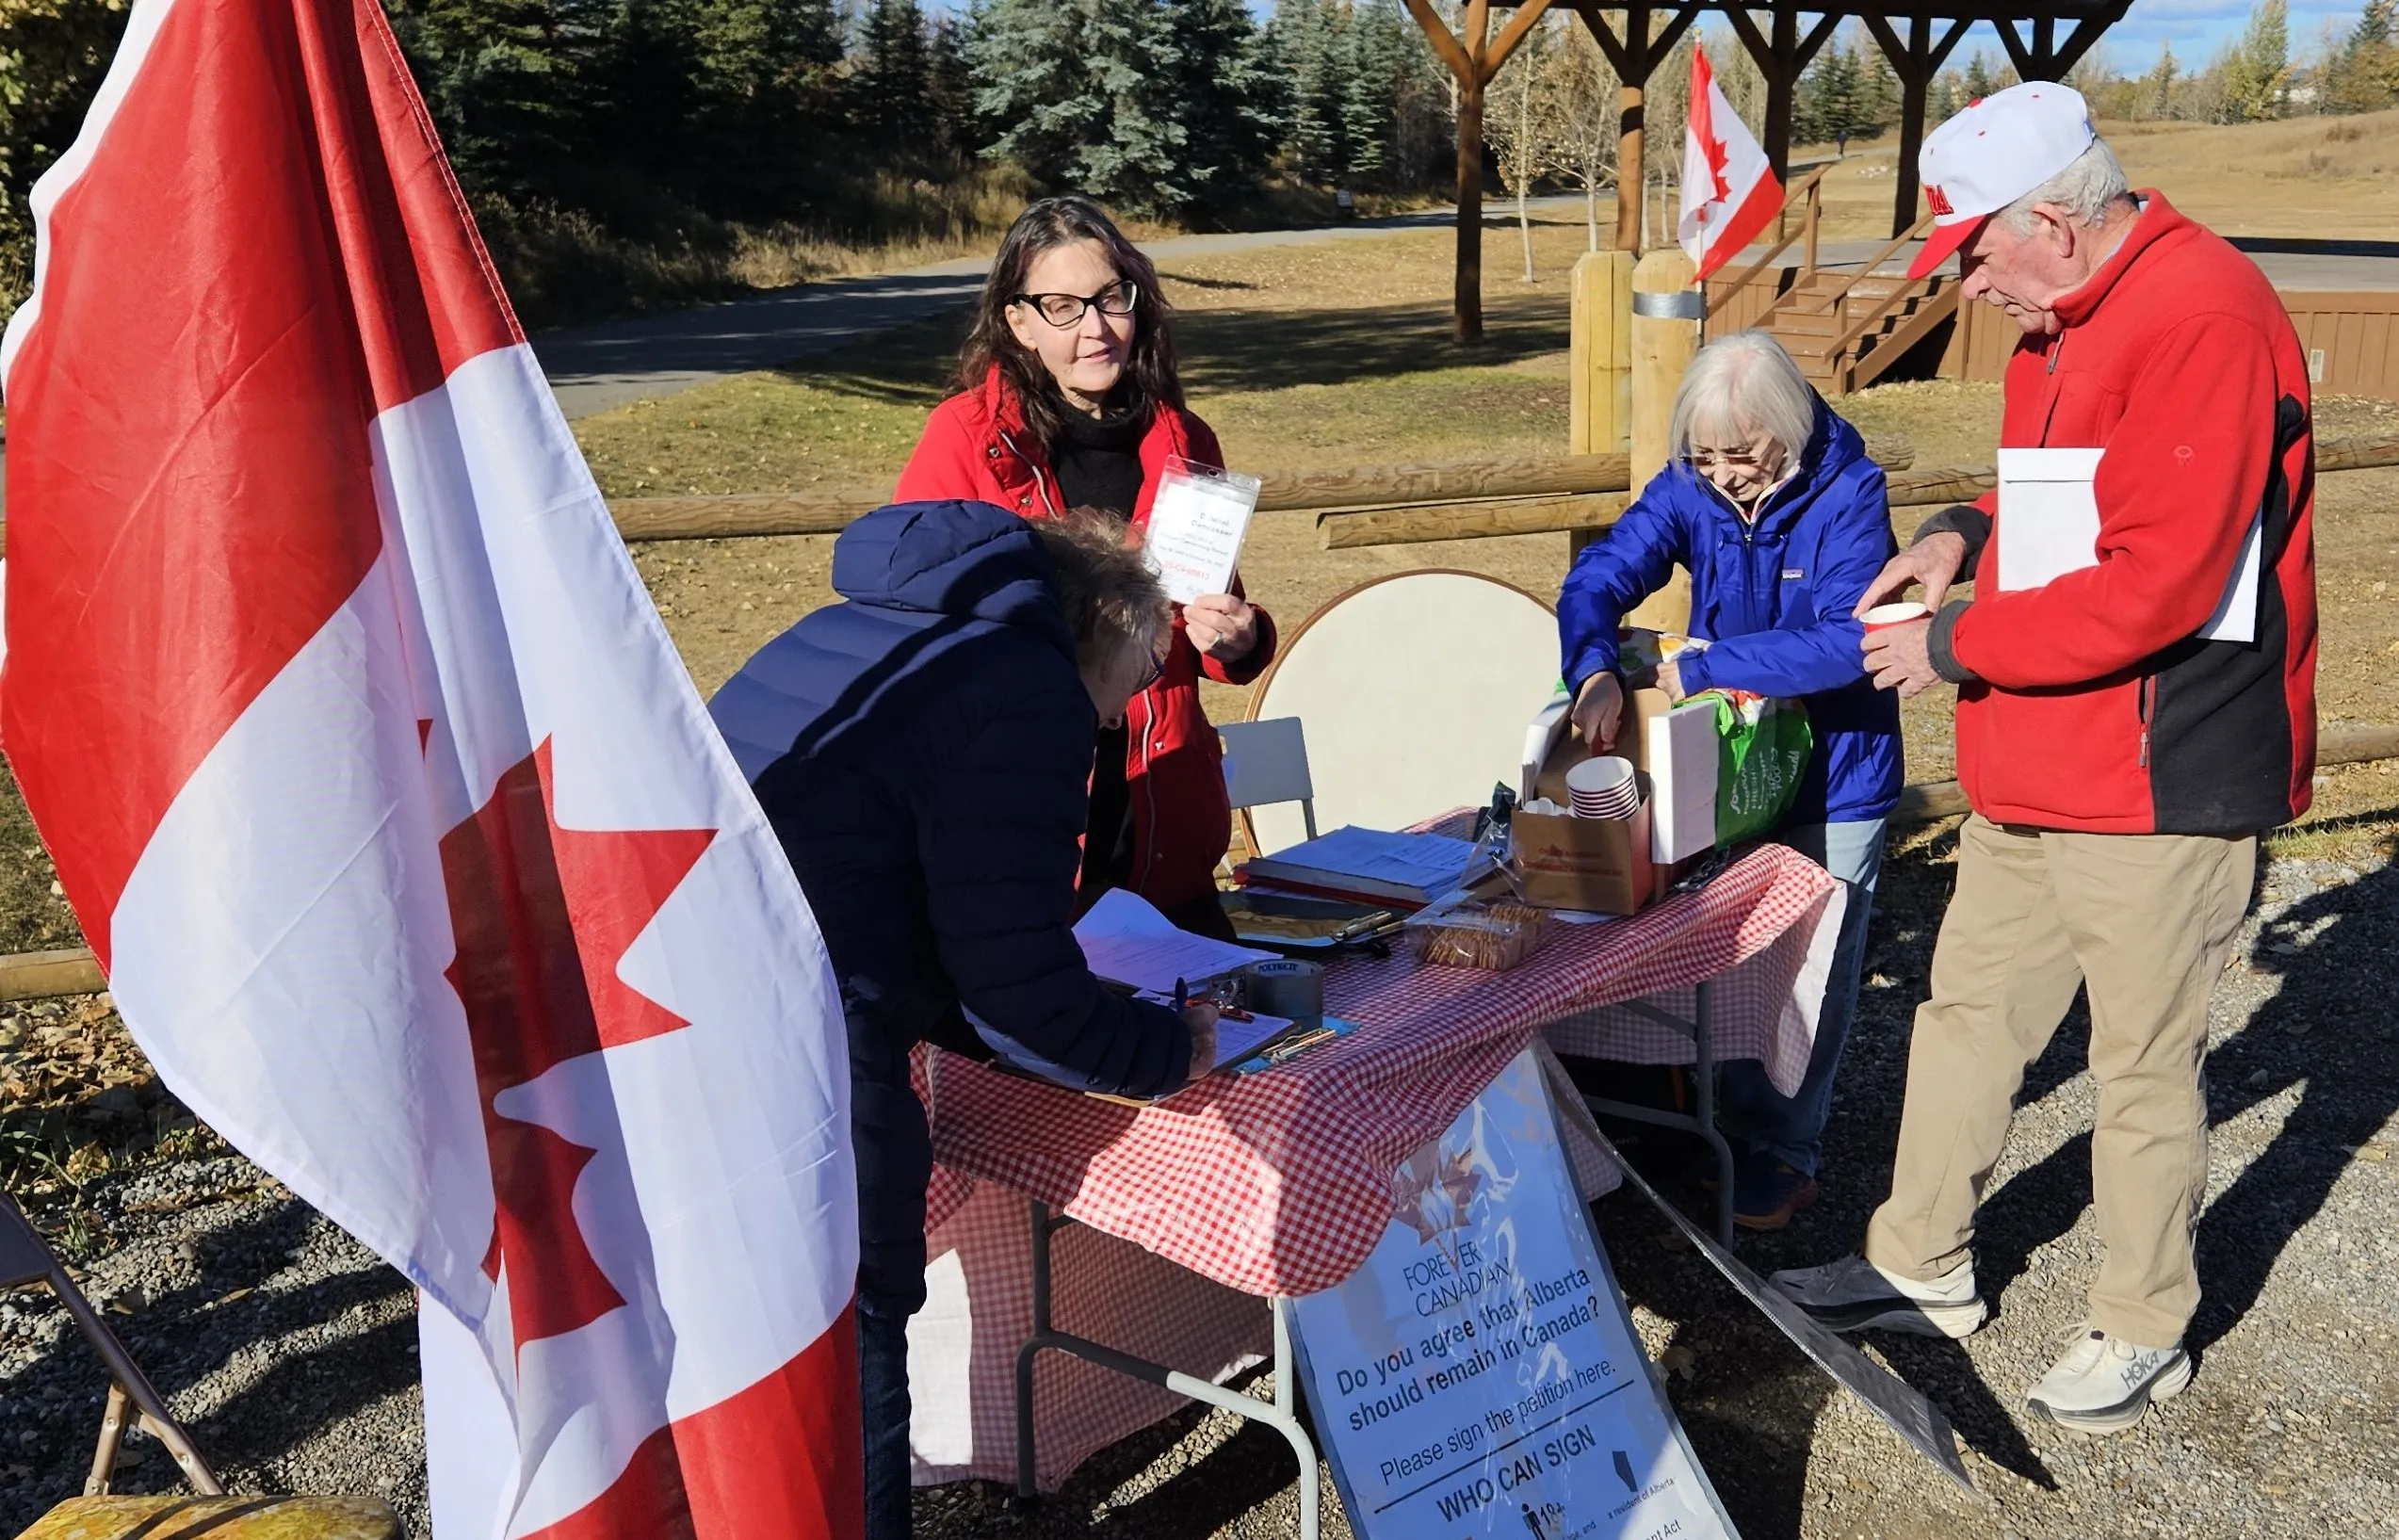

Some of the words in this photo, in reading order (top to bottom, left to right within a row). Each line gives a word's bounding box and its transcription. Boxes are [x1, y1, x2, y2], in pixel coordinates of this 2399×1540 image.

[1402, 1240, 1483, 1291] FOREVER
[1416, 1256, 1512, 1317] CANADIAN
[1336, 1369, 1369, 1397] Do
[1373, 1347, 1415, 1386] you
[1419, 1320, 1476, 1358] agree
[1479, 1296, 1519, 1331] that
[1523, 1269, 1592, 1312] Alberta
[1349, 1377, 1425, 1432] should
[1426, 1348, 1498, 1395] remain
[1496, 1337, 1521, 1361] in
[1521, 1295, 1599, 1349] Canada?
[2120, 1351, 2161, 1391] HOKA
[1379, 1442, 1445, 1485] Please
[1448, 1422, 1485, 1451] sign
[1484, 1408, 1516, 1434] the
[1517, 1379, 1576, 1418] petition
[1574, 1359, 1616, 1389] here.
[1435, 1477, 1496, 1523] WHO
[1498, 1451, 1545, 1492] CAN
[1544, 1423, 1597, 1467] SIGN
[1613, 1494, 1643, 1517] resident
[1642, 1488, 1650, 1500] of
[1662, 1518, 1681, 1538] Act
